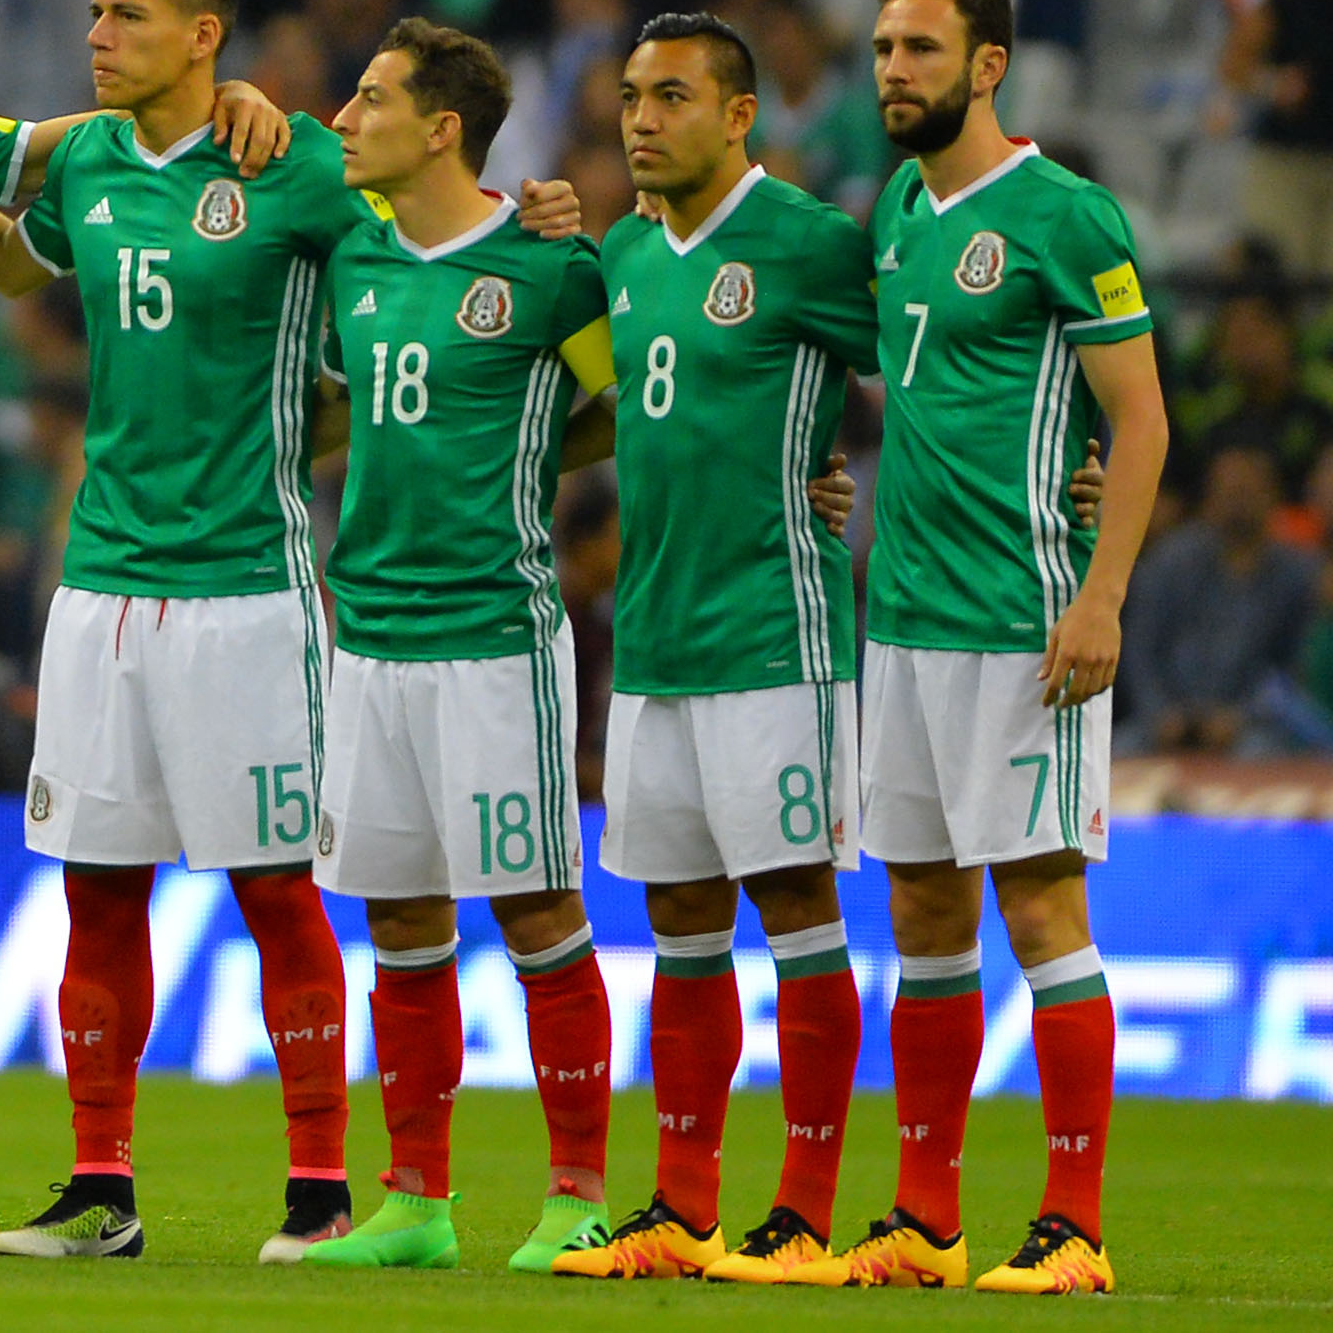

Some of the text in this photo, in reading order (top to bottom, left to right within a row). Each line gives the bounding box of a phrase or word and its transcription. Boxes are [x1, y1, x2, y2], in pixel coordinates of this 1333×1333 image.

[116, 246, 174, 332] 15
[1102, 285, 1129, 303] FIFA
[370, 341, 429, 426] 18
[642, 334, 677, 420] 8
[903, 302, 930, 388] 7
[248, 762, 312, 848] 15
[472, 791, 535, 876] 18
[778, 764, 821, 846] 8
[1009, 754, 1051, 839] 7
